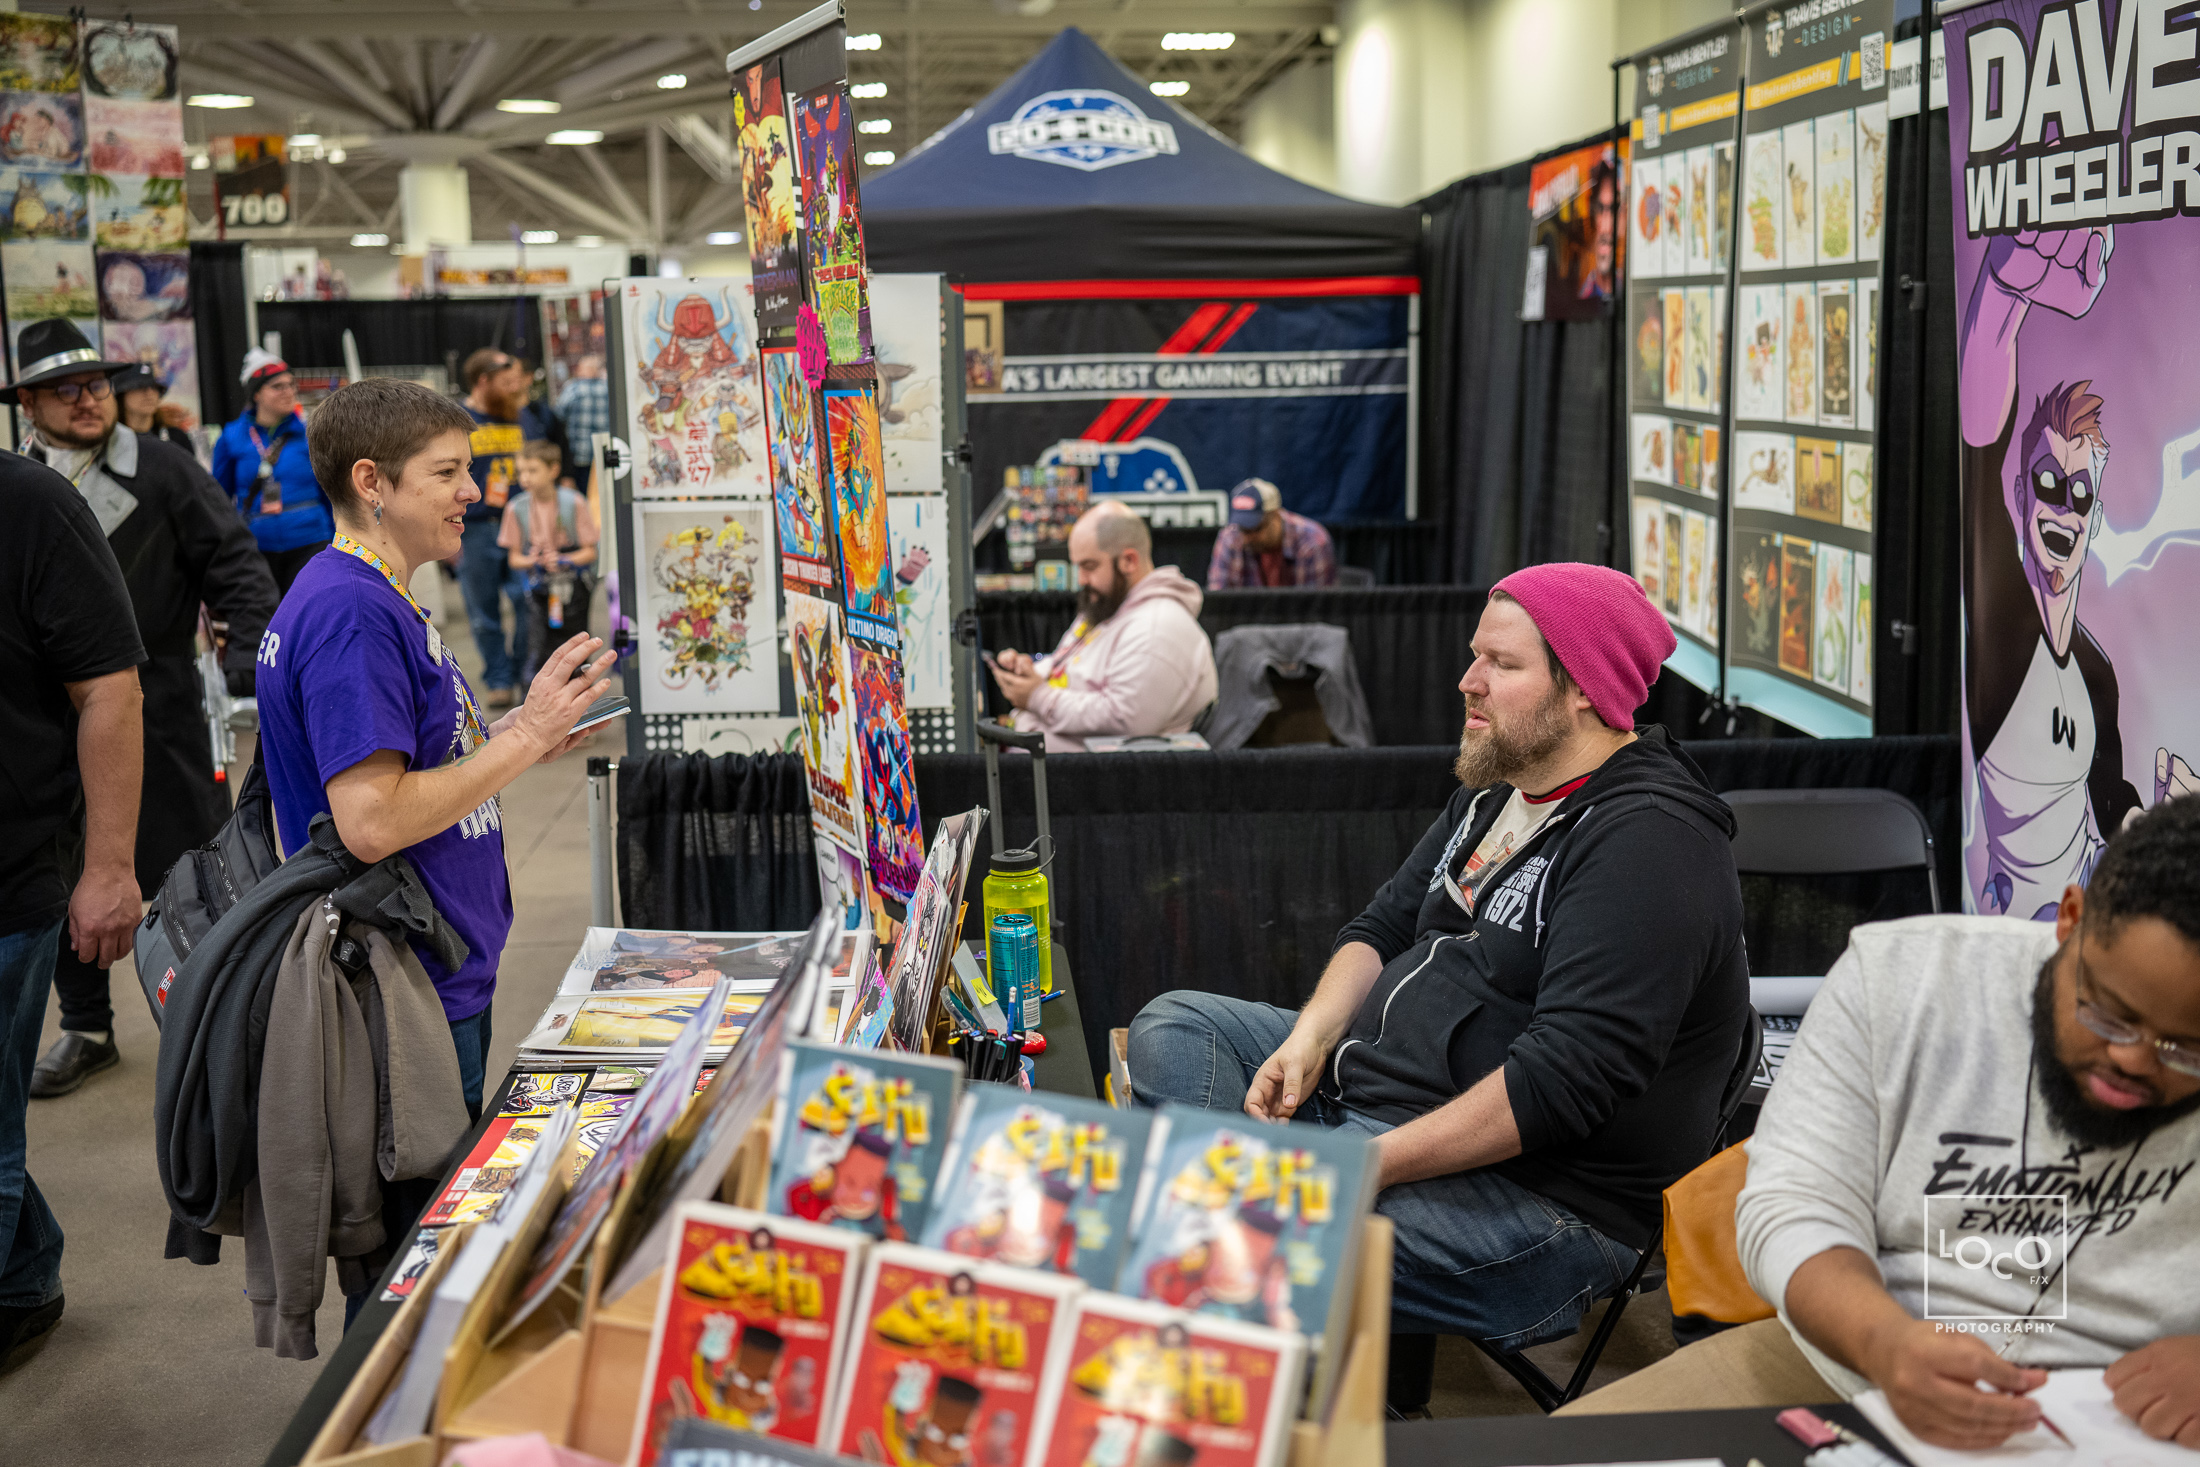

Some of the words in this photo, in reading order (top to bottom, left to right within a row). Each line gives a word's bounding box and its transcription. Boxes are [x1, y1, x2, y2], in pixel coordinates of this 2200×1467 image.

[1802, 12, 1851, 47] DESIGN
[1968, 0, 2200, 153] DAVE
[1966, 130, 2200, 233] WHEELER
[220, 193, 287, 226] 700
[1044, 362, 1151, 390] LARGEST
[1156, 361, 1261, 388] GAMING
[1265, 360, 1346, 387] EVENT
[847, 616, 874, 640] ULTIMO
[875, 624, 900, 649] DRAGON
[1484, 886, 1529, 932] 1972
[1924, 1132, 2196, 1207] EMOTIONALLY
[1957, 1208, 2138, 1237] EXHAUSTED
